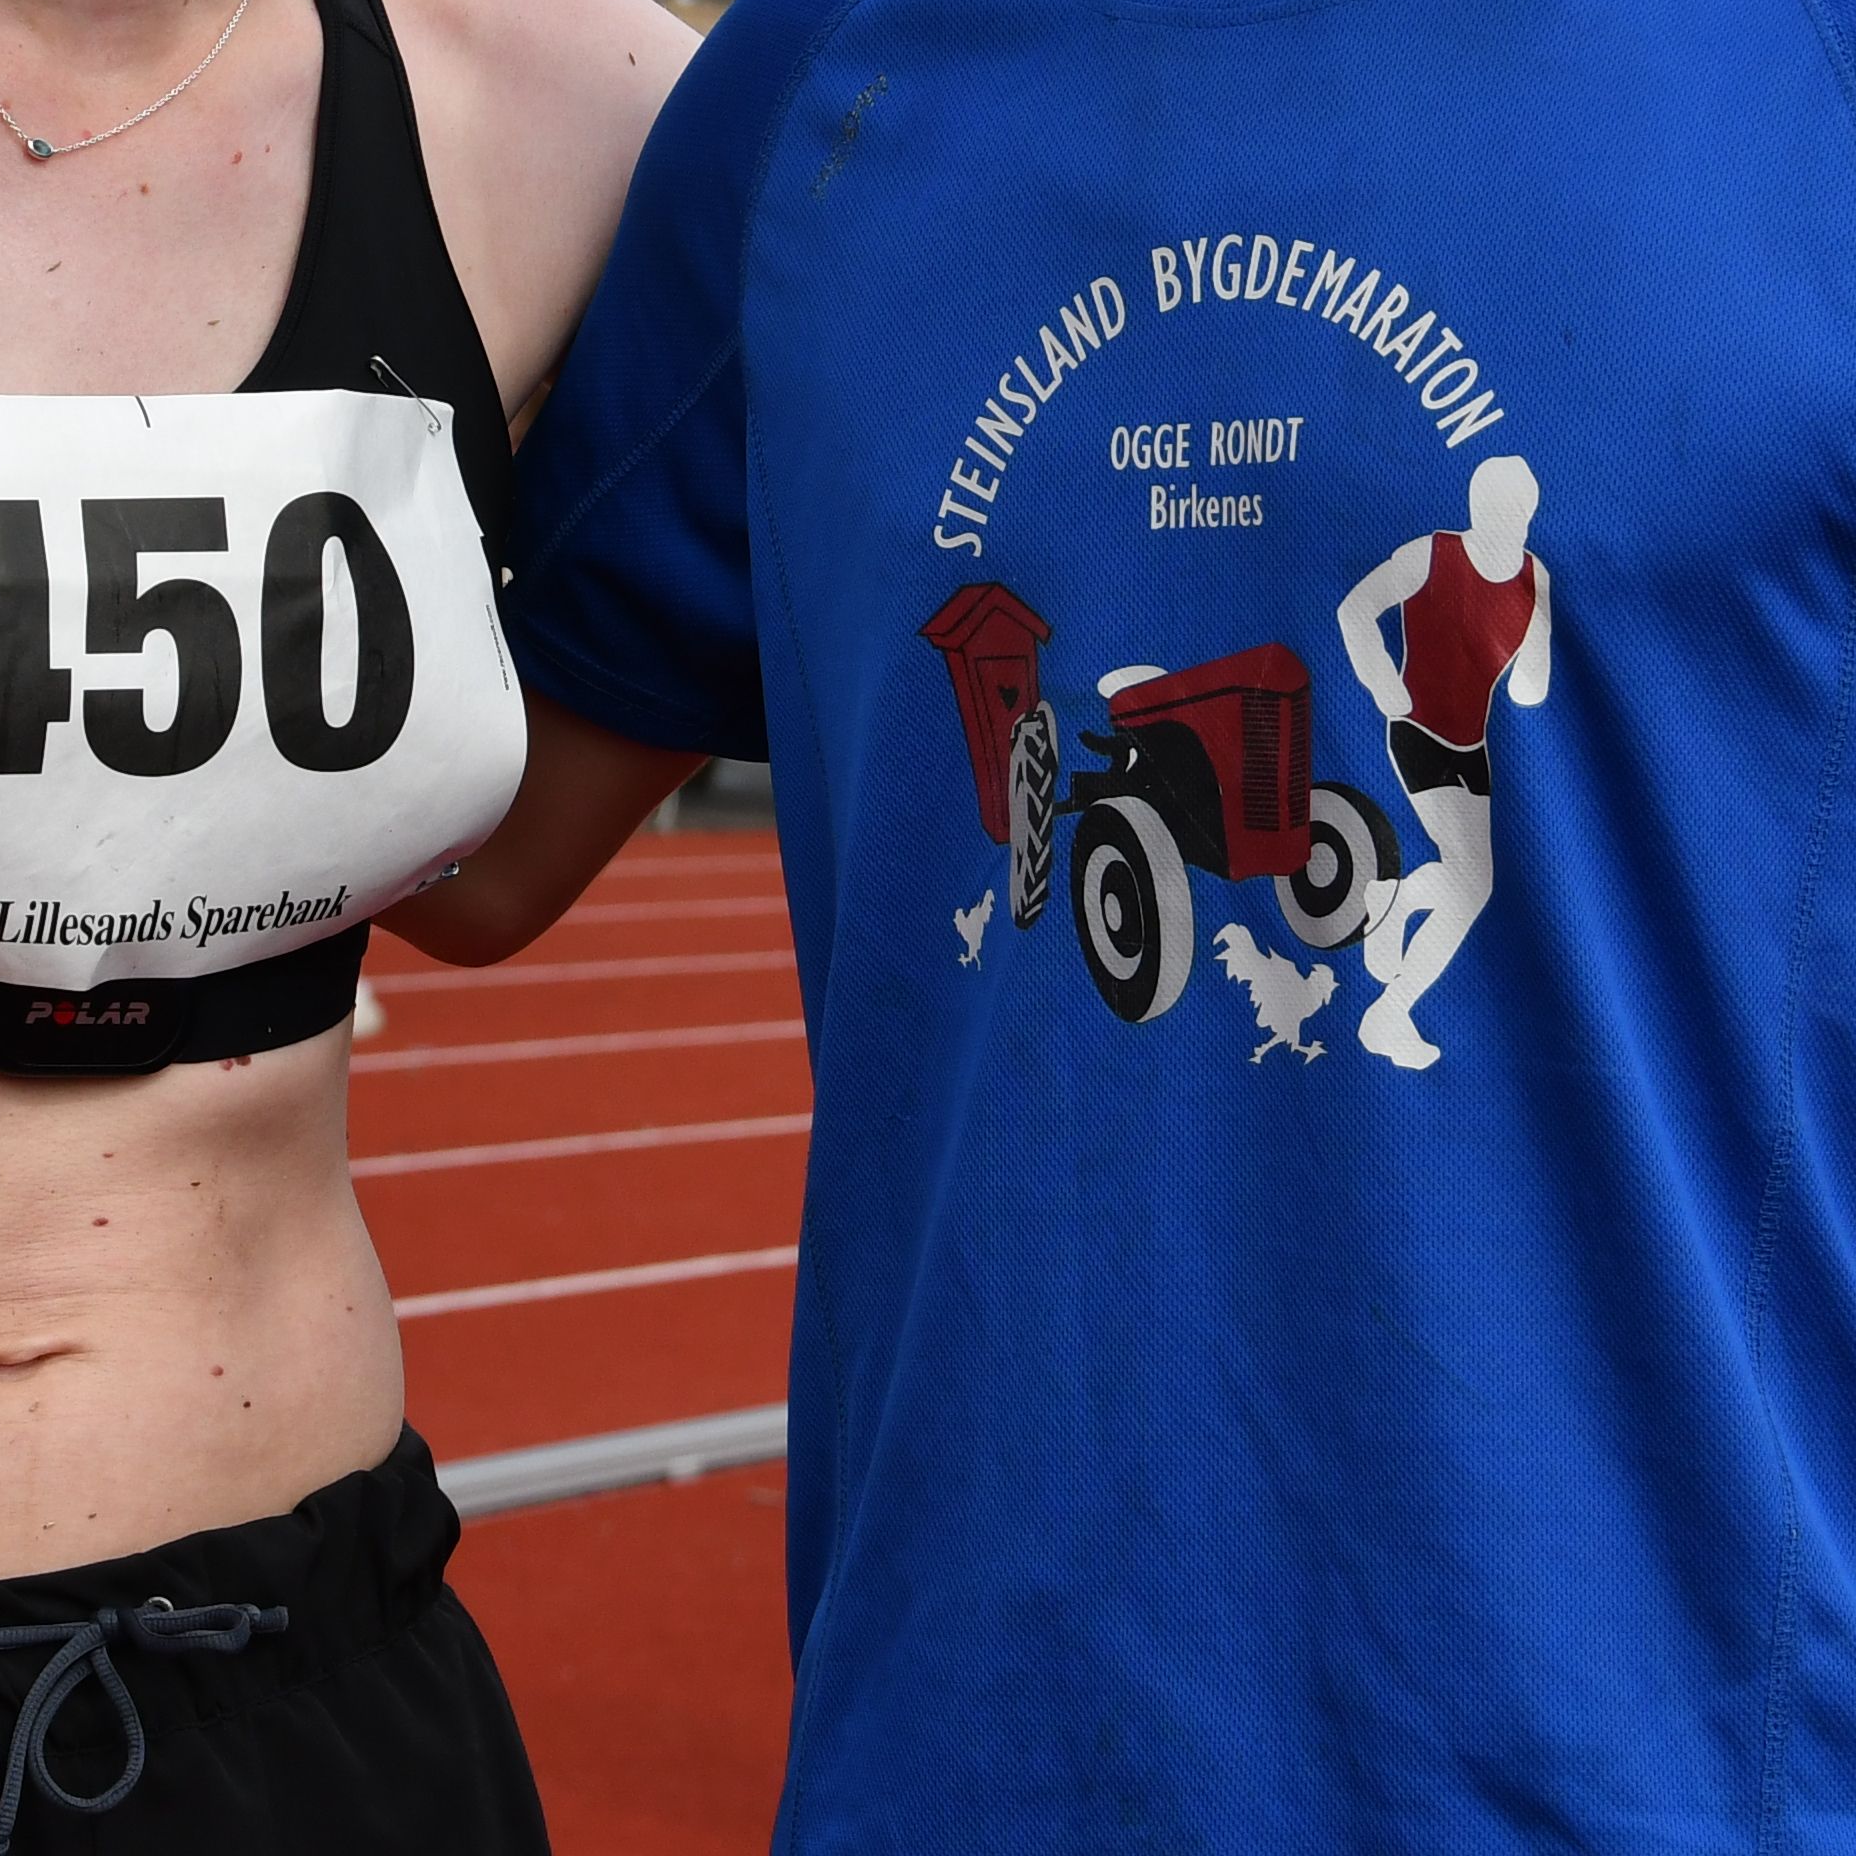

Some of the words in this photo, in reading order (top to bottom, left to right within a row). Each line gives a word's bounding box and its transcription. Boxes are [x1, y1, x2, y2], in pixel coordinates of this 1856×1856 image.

[933, 276, 1127, 558] STEINSLAND
[1151, 233, 1505, 449] BYGDEMARATON
[1110, 422, 1192, 471] OGGE
[1209, 416, 1305, 467] RONDT
[1149, 482, 1265, 531] Birkenes
[178, 883, 353, 949] Sparebank
[24, 1000, 151, 1027] POLAR
